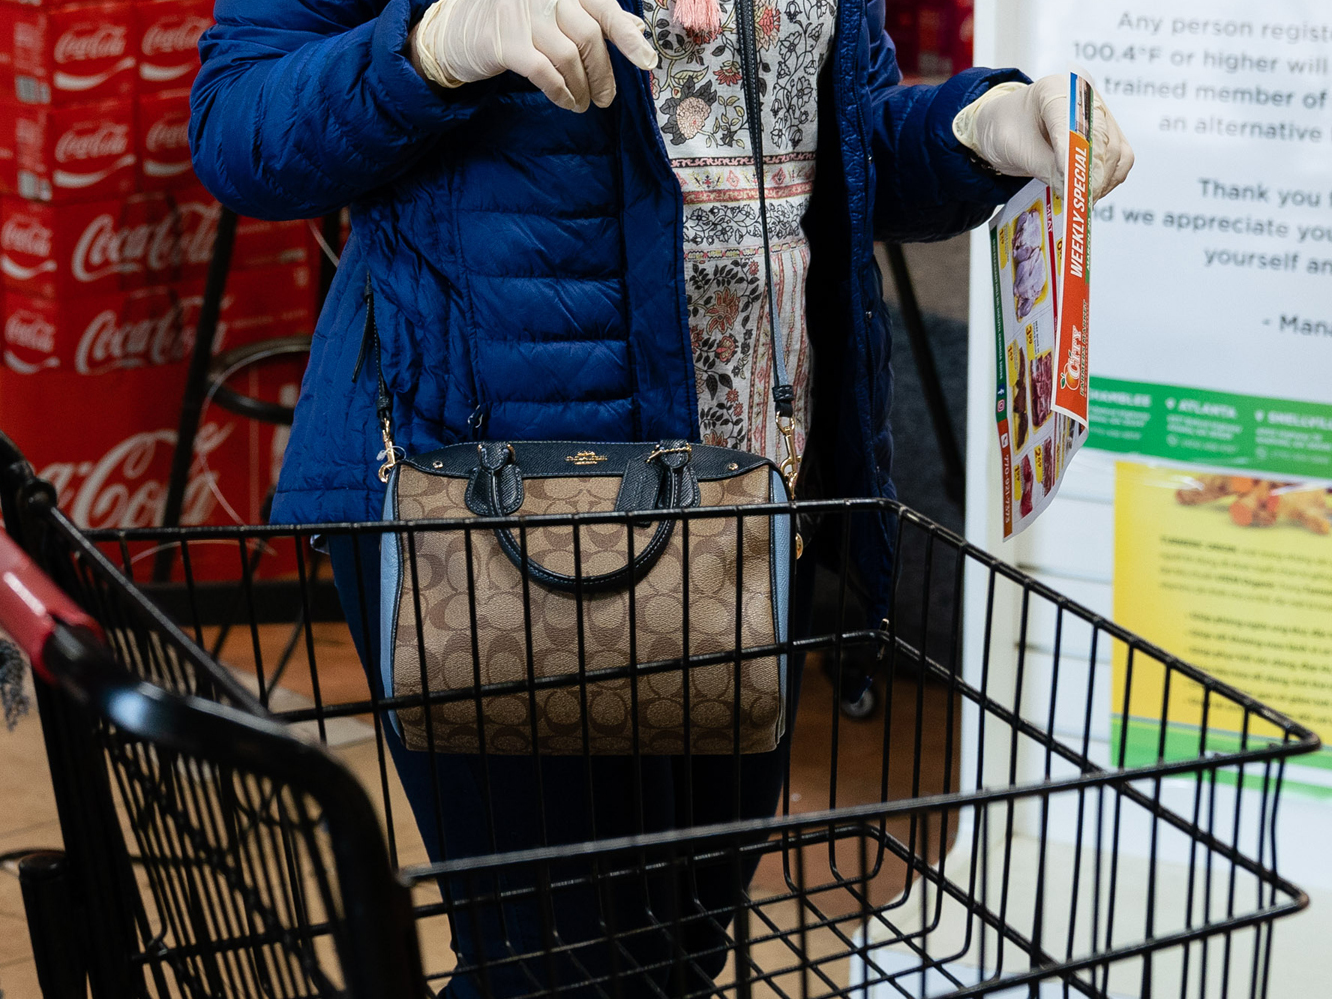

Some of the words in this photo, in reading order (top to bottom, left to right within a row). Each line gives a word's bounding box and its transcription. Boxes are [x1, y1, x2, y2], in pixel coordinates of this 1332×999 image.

[1118, 12, 1163, 35] Any
[1171, 17, 1254, 38] person
[1170, 49, 1195, 67] or
[1203, 49, 1279, 75] higher
[1287, 57, 1328, 76] will
[1104, 75, 1188, 100] trained
[1195, 84, 1294, 107] member
[1302, 92, 1328, 110] of
[1159, 115, 1188, 132] an
[1195, 115, 1323, 143] alternative
[1073, 145, 1087, 213] SPECIAL
[1198, 177, 1269, 203] Thank
[1277, 189, 1321, 209] you
[1122, 209, 1155, 226] we
[1162, 211, 1289, 239] appreciate
[1070, 209, 1086, 279] WEEKLY
[1203, 247, 1299, 271] yourself
